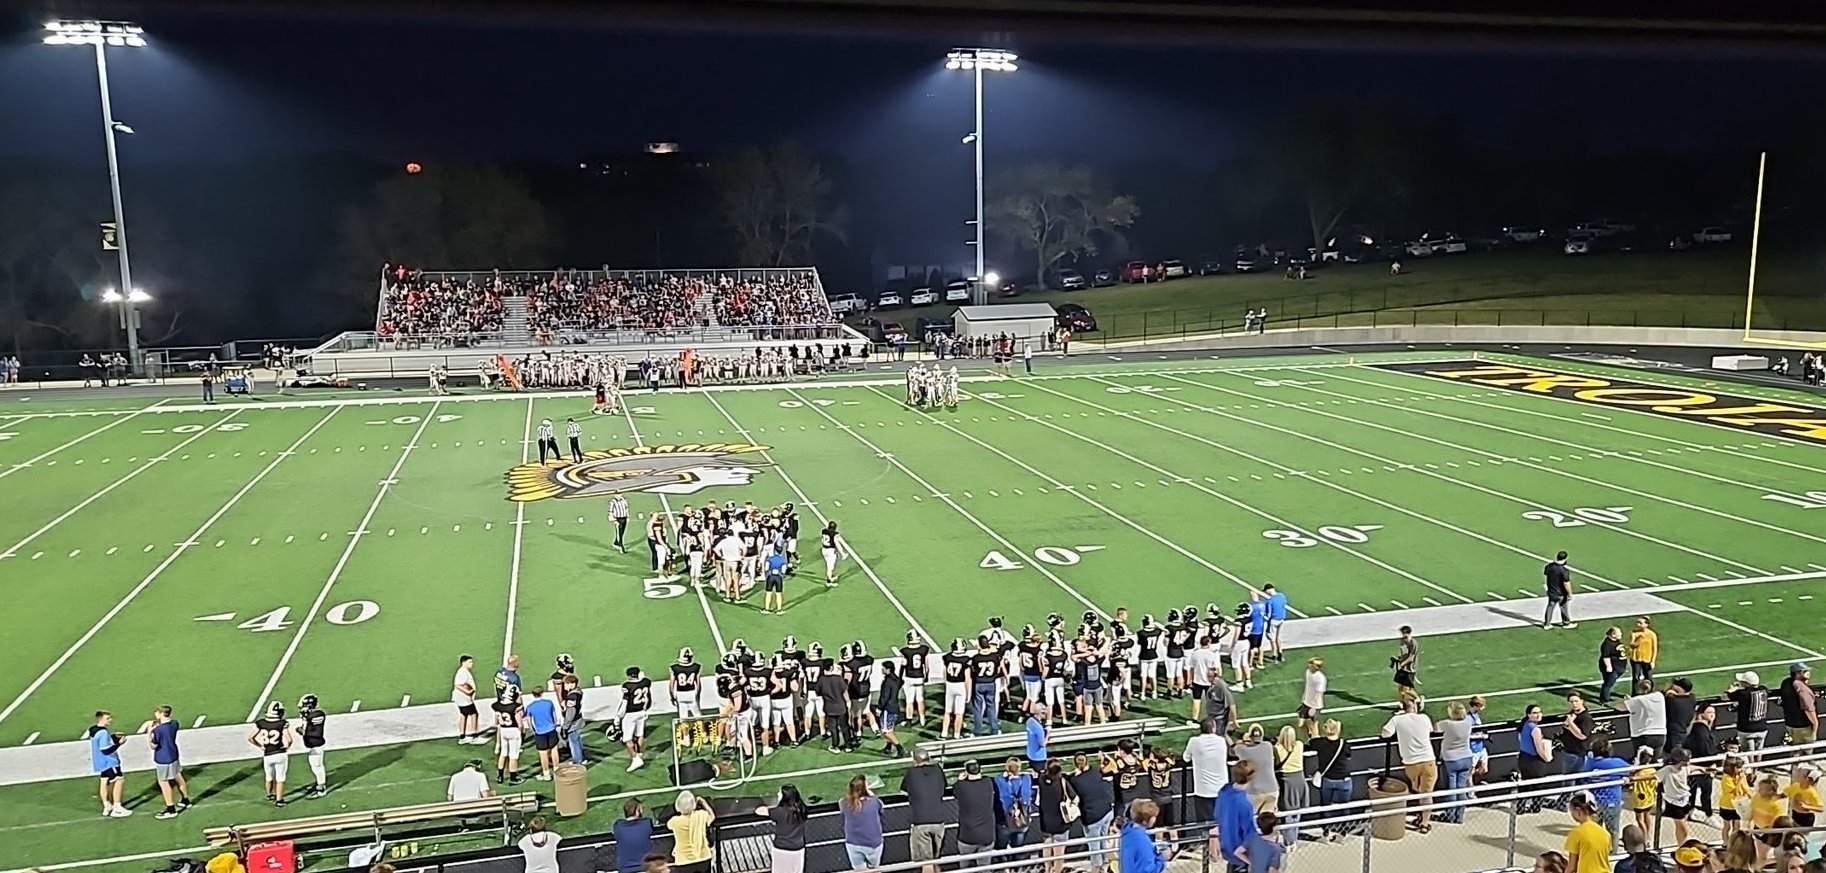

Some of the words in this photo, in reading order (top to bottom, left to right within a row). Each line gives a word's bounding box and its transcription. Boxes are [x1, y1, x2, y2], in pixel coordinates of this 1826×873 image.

[1521, 507, 1630, 527] 20
[1262, 526, 1369, 548] 30
[979, 546, 1081, 571] 40
[236, 600, 381, 632] 40
[912, 654, 922, 669] 6
[947, 662, 963, 677] 47
[978, 661, 995, 677] 73
[678, 672, 696, 687] 84
[805, 666, 820, 682] 17
[749, 676, 767, 692] 53
[258, 728, 280, 745] 82
